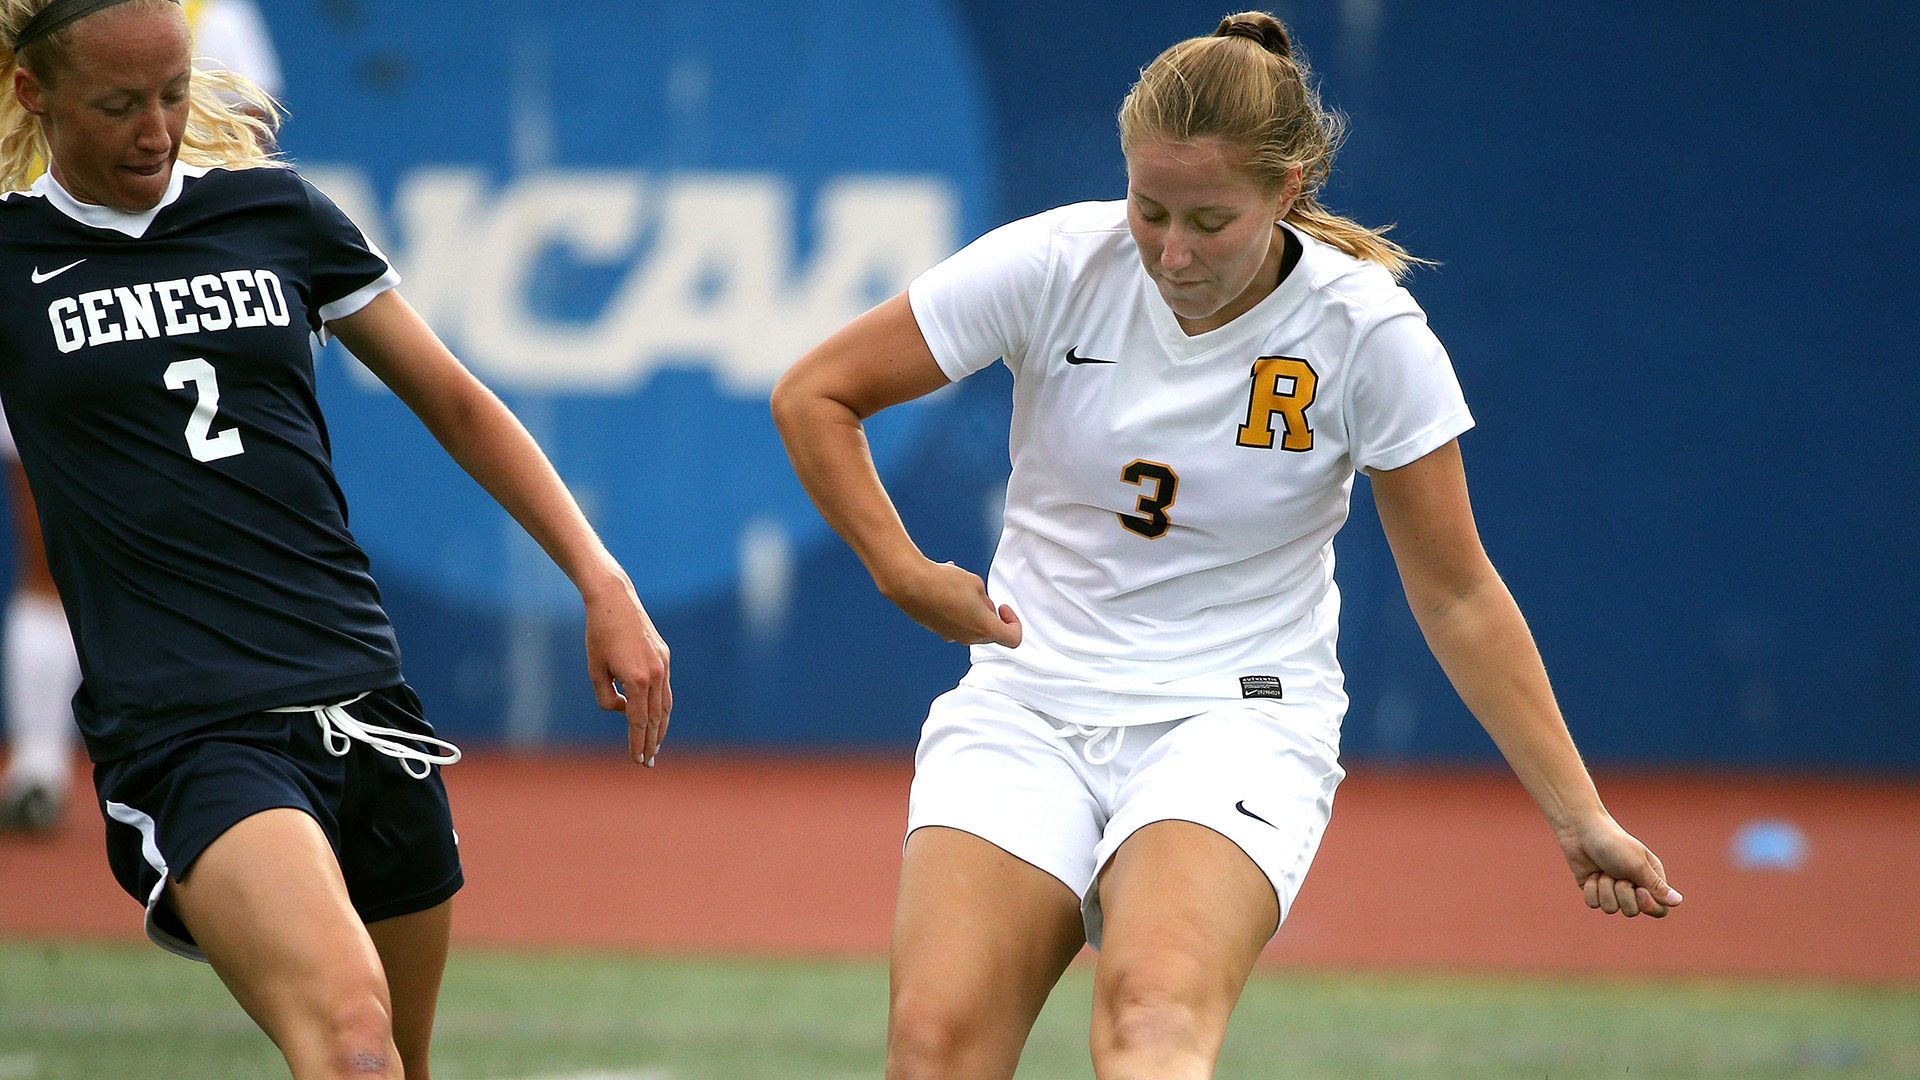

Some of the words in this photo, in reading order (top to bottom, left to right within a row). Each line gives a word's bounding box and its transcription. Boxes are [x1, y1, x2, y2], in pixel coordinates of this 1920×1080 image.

[47, 269, 292, 354] GENESEO
[162, 357, 246, 463] 2
[1235, 354, 1320, 452] R
[1116, 457, 1180, 541] 3
